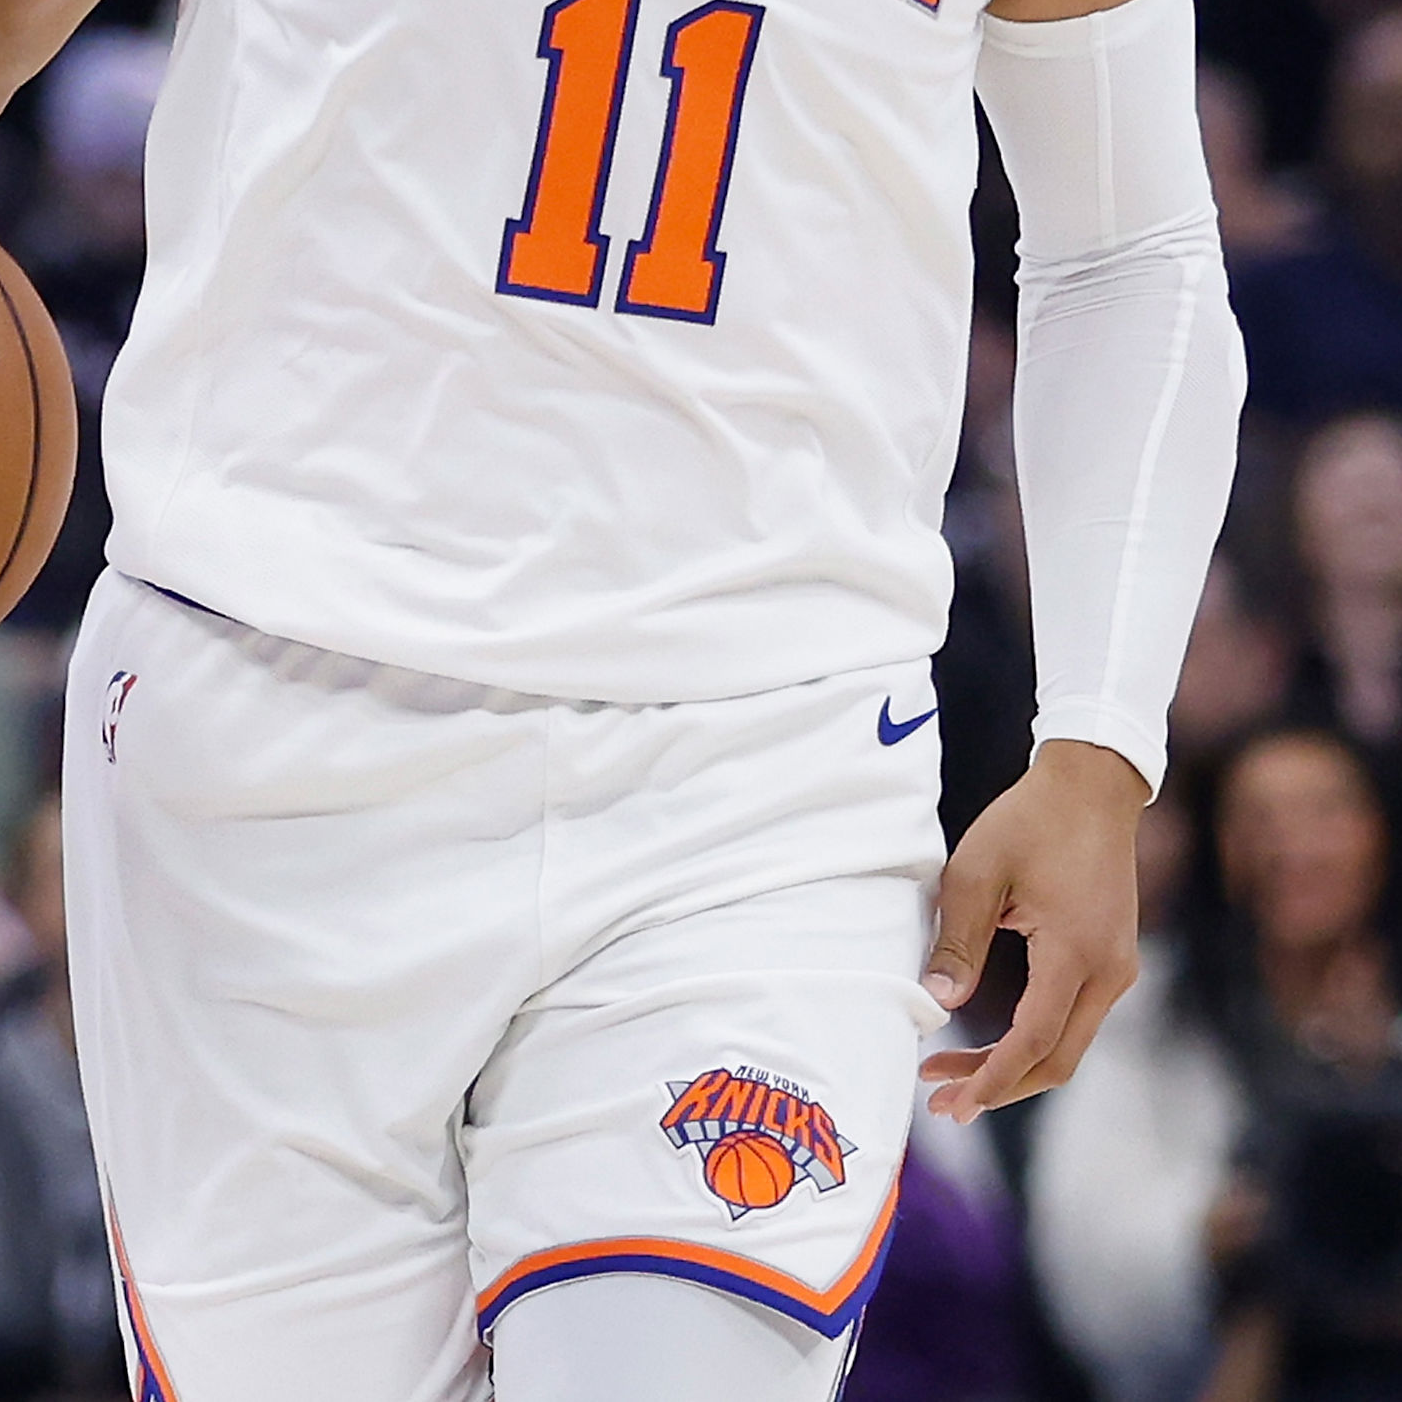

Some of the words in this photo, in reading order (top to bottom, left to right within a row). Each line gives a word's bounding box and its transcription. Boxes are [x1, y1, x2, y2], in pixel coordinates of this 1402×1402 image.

[734, 1065, 769, 1082] NEW
[773, 1073, 810, 1102] YORK
[660, 1067, 845, 1190] KNICKS
